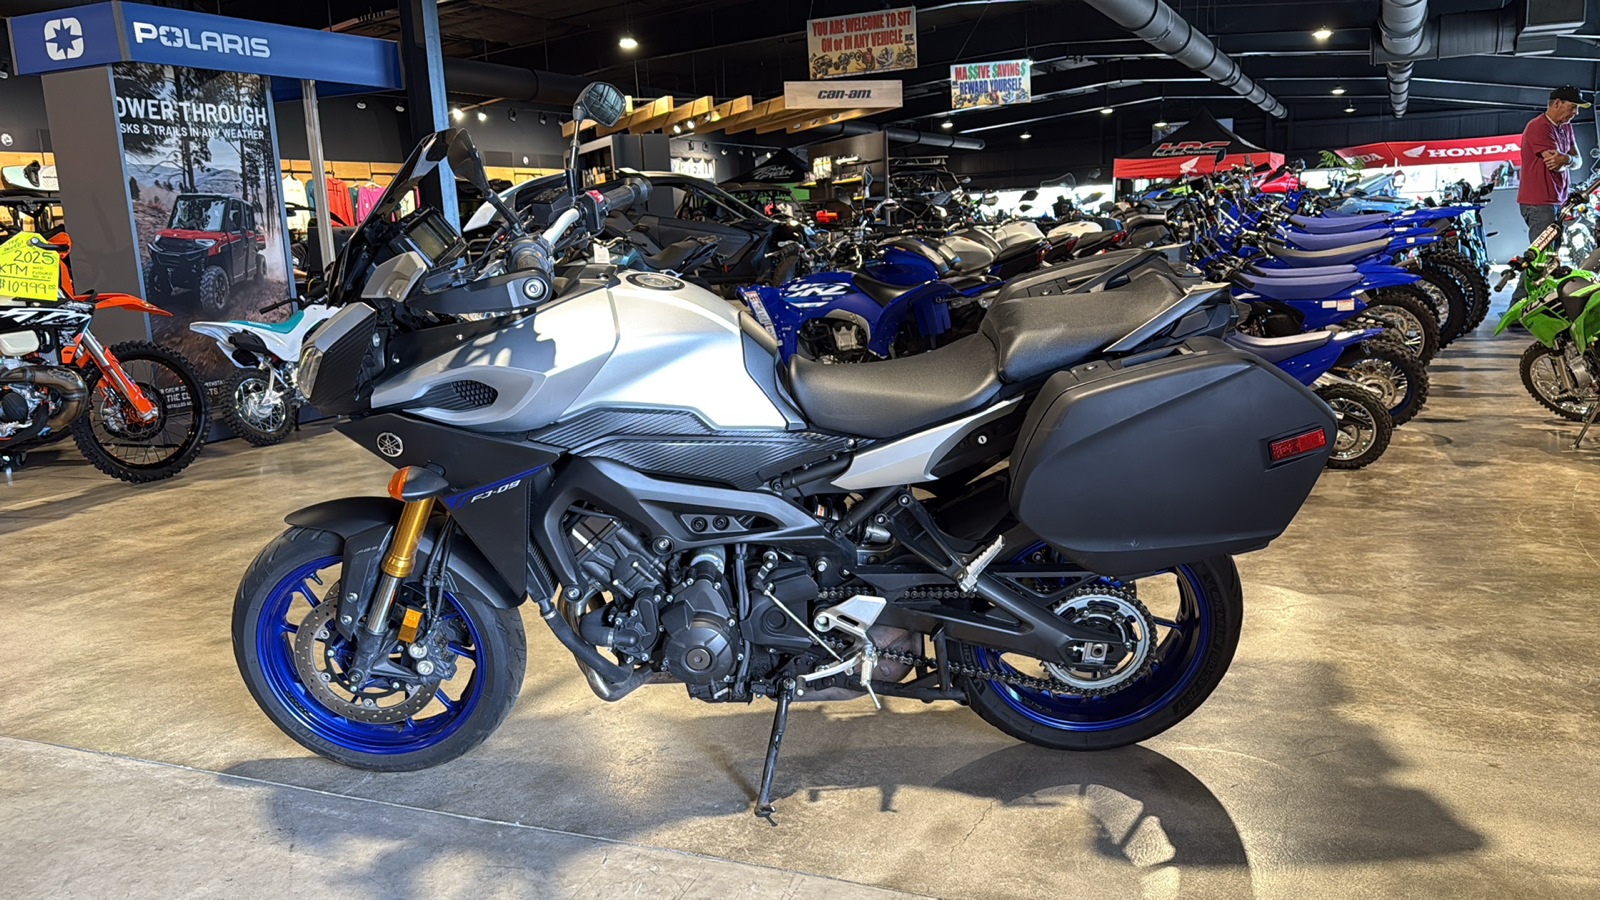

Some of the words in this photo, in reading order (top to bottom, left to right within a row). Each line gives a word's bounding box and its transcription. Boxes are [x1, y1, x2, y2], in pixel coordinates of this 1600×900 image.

[812, 21, 828, 37] YOU
[830, 19, 844, 34] ARE
[845, 14, 884, 33] WELCOME
[885, 12, 896, 28] TO
[898, 10, 911, 26] SIT
[133, 22, 271, 58] POLARIS
[822, 37, 832, 53] ON
[834, 38, 842, 51] or
[844, 35, 852, 50] IN
[854, 32, 870, 48] ANY
[871, 29, 903, 47] VEHICLE
[959, 80, 988, 95] REWARD
[990, 77, 1022, 92] YOURSELF
[116, 97, 175, 121] OWER
[179, 102, 267, 126] THROUGH
[121, 123, 140, 134] SKS
[142, 124, 150, 134] &
[153, 125, 188, 137] TRAILS
[190, 127, 200, 138] IN
[202, 128, 220, 138] ANY
[222, 128, 264, 140] WEATHER
[1427, 143, 1521, 158] HONDA
[13, 250, 54, 265] 2025
[0, 263, 28, 276] KTM
[166, 393, 181, 402] THE
[470, 480, 521, 503] FJ-09
